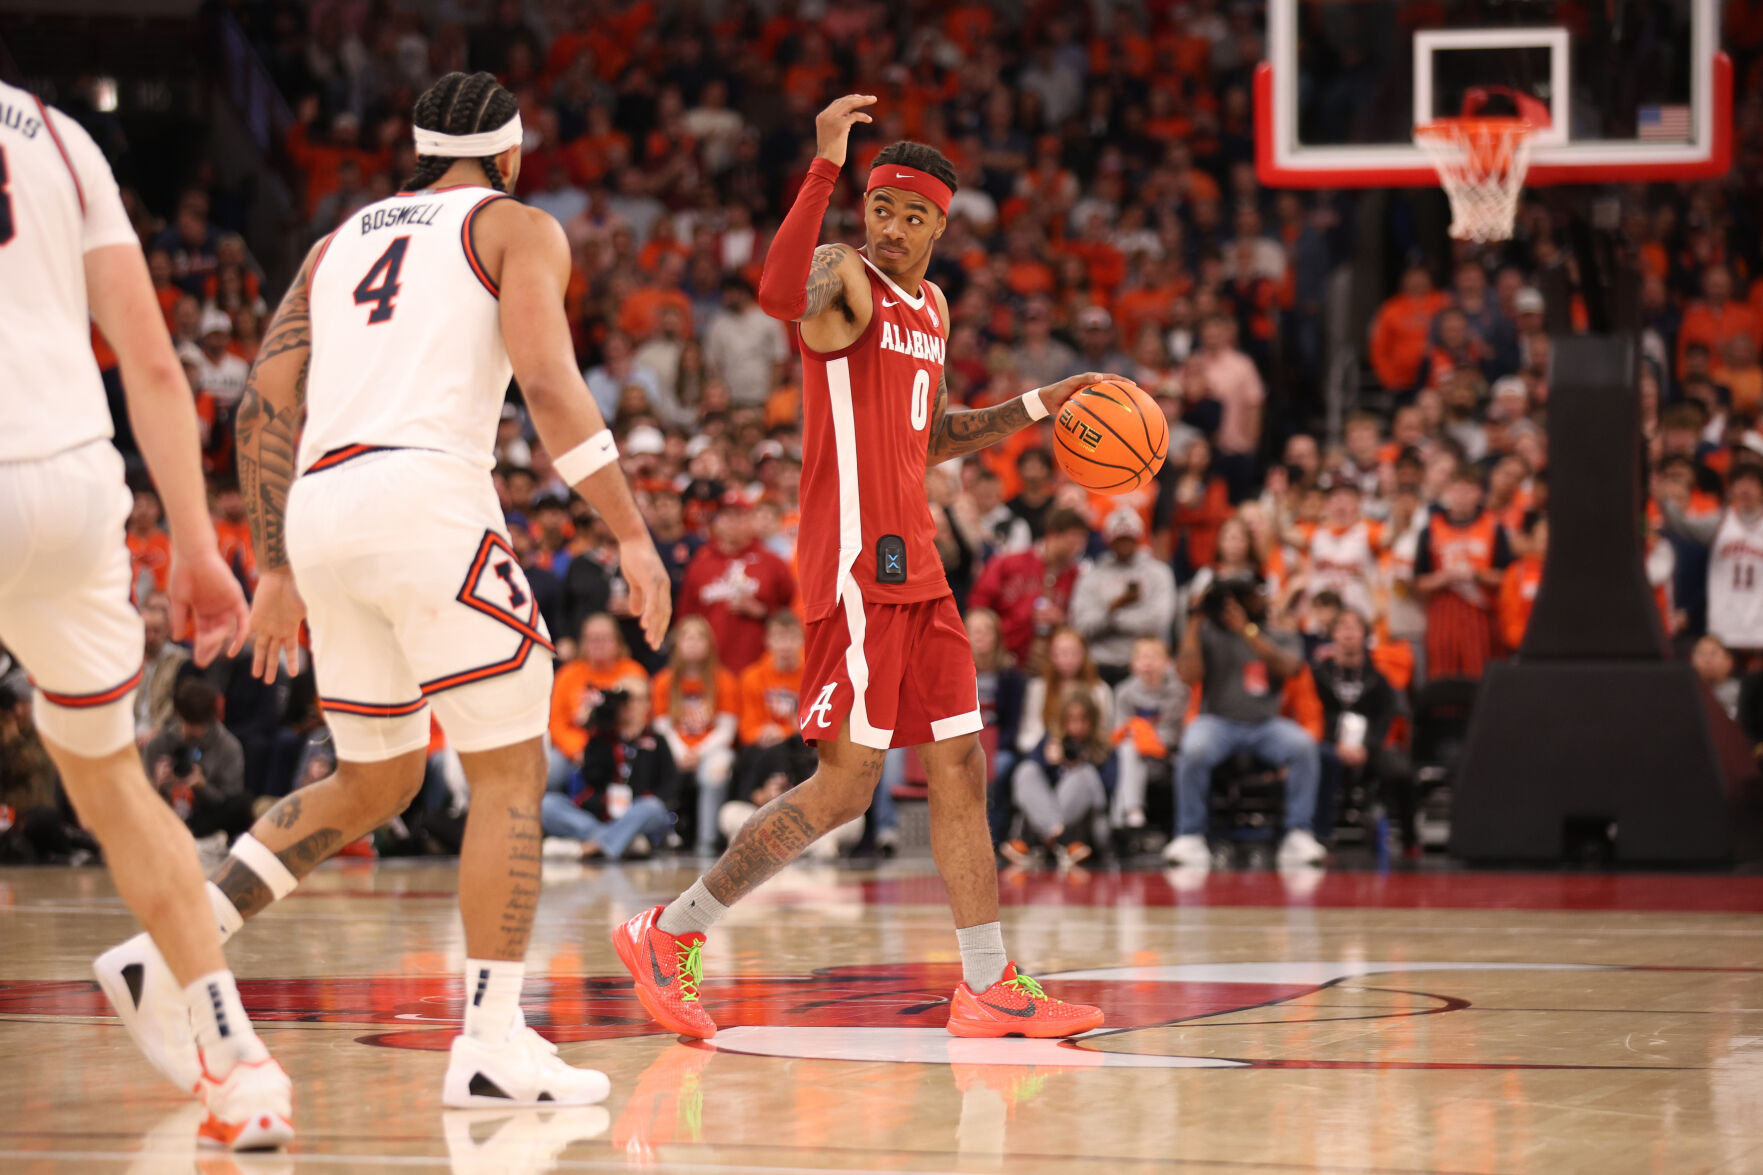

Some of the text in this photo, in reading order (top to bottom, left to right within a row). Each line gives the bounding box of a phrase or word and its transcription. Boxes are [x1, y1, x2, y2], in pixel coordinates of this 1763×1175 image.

[0, 103, 41, 140] US
[361, 203, 444, 236] BOSWELL
[352, 234, 412, 326] 4
[910, 368, 930, 431] 0
[1059, 408, 1103, 449] ELITE
[800, 681, 838, 731] A
